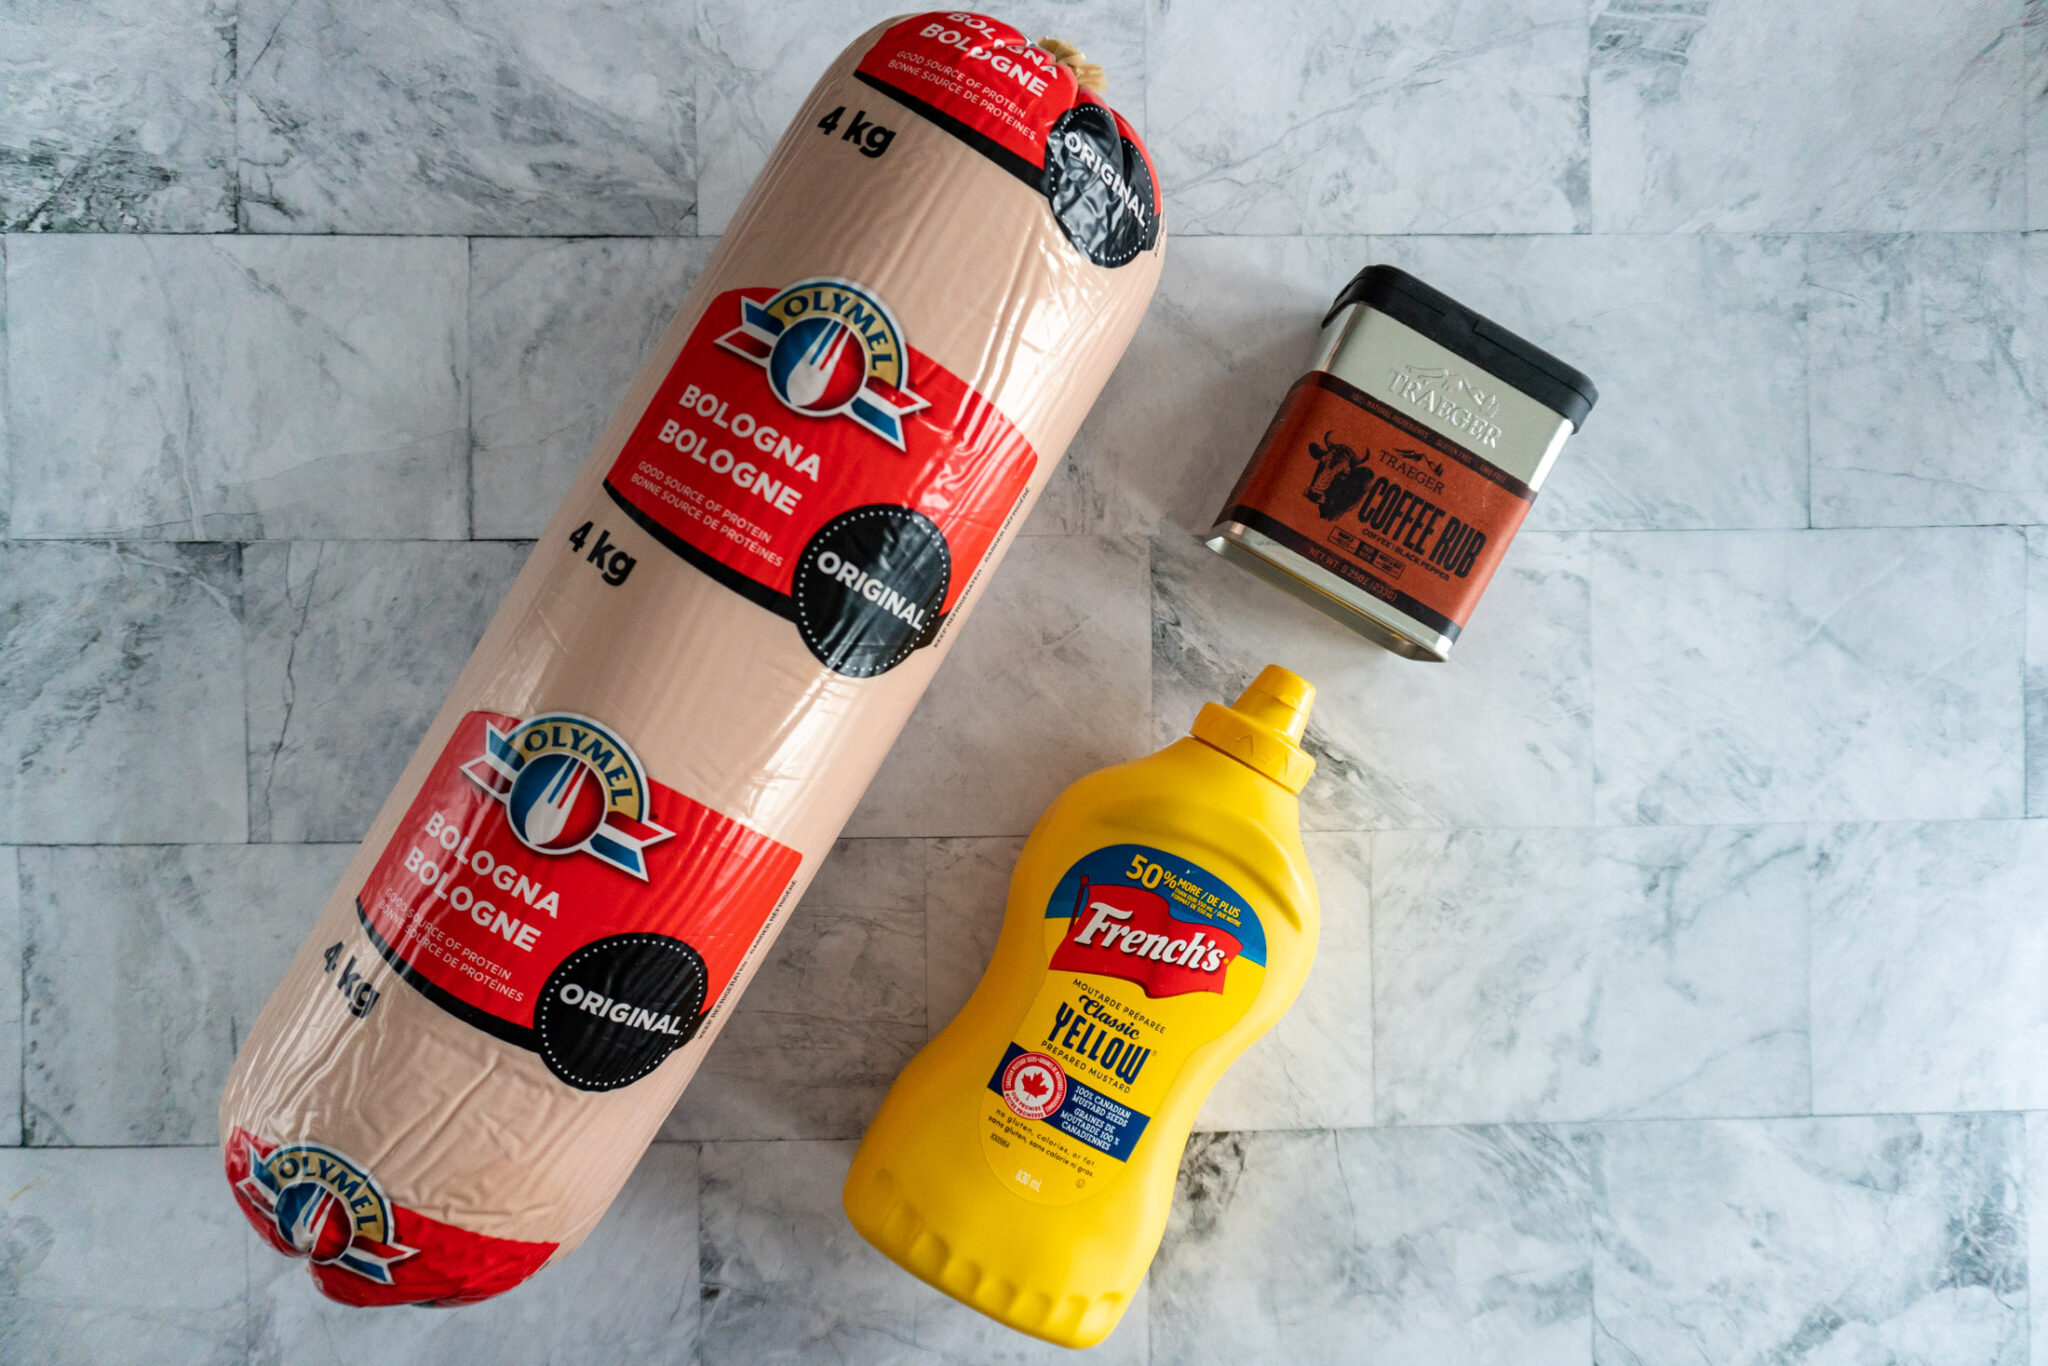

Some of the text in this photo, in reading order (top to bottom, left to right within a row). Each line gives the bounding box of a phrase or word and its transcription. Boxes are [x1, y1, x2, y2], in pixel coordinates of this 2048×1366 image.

[897, 51, 1026, 118] GOOD SOURCE OF PROTEIN
[920, 23, 1048, 97] BOLOGNE
[817, 106, 896, 159] 4 kg
[888, 59, 1037, 141] BONNE SOURCE DE PROTÉINES
[1064, 131, 1148, 228] ORIGINAL
[784, 290, 893, 371] OLYMEL
[679, 384, 821, 483] BOLOGNA
[1388, 369, 1502, 448] TRAEGER
[638, 461, 772, 544] GOOD SOURCE OF PROTEIN
[658, 419, 802, 515] BOLOGNE
[1378, 449, 1445, 495] TRAEGER
[569, 521, 637, 587] 4 kg
[631, 473, 784, 567] BONNE SOURCE DE PROTÉINES
[1358, 477, 1487, 578] COFFEE RUB
[1362, 528, 1391, 548] COFFEE
[1395, 548, 1419, 564] BLACK
[1421, 562, 1450, 581] PEPPER
[817, 551, 926, 631] ORIGINAL
[524, 726, 633, 806] OLYMEL
[404, 846, 542, 952] BOLOGNE
[425, 811, 560, 919] BOLOGNA
[1126, 853, 1177, 890] 50%
[1176, 878, 1202, 897] MORE
[1208, 894, 1220, 908] DE
[1219, 900, 1241, 918] PLUS
[385, 888, 512, 981] GOOD SOURCE OF PROTEIN
[404, 925, 444, 958] SOURCE
[443, 954, 460, 969] DE
[1074, 901, 1225, 972] French's
[324, 941, 380, 1019] 4 kg
[560, 983, 683, 1036] ORIGINAL
[1073, 979, 1167, 1034] MOUTARDE PRÉPARÉE
[1048, 1002, 1152, 1085] YELLOW
[1079, 995, 1141, 1040] Classic
[1041, 1040, 1131, 1094] PREPARED MUSTARD
[1075, 1085, 1131, 1119] 100% CANADIAN
[988, 1115, 1004, 1129] sans
[1004, 1123, 1028, 1144] gluten,
[1029, 1140, 1045, 1152] sans
[1046, 1147, 1070, 1165] calorie
[995, 1109, 1006, 1119] no
[1007, 1117, 1035, 1136] gluten,
[1036, 1132, 1070, 1156] calories,
[1060, 1110, 1101, 1138] MOUTARDE
[1099, 1131, 1114, 1143] 100
[1061, 1122, 1112, 1151] CANADIENNES
[1072, 1095, 1129, 1128] MUSTARD SEEDS
[1073, 1108, 1116, 1133] GRAINES DE
[278, 1156, 377, 1232] OLYMEL
